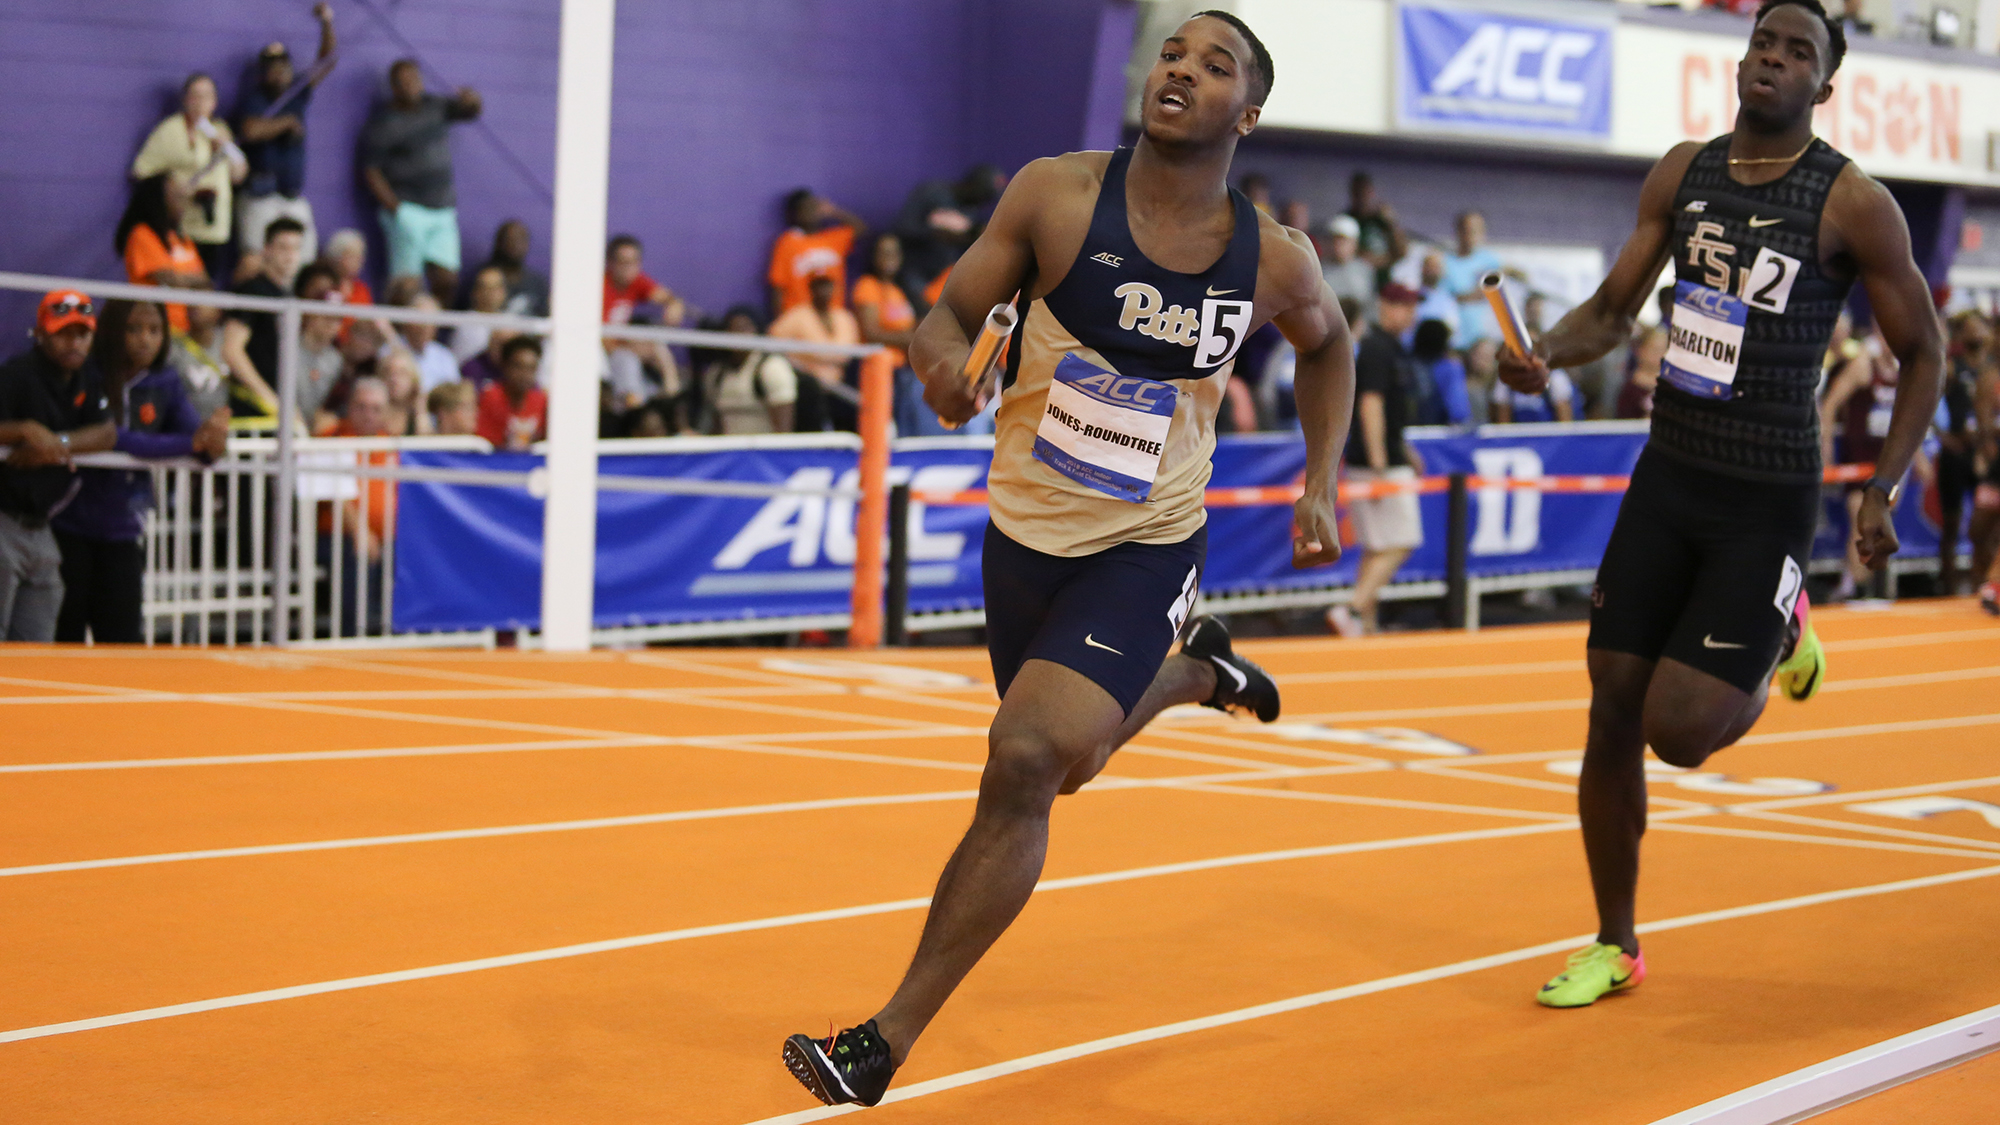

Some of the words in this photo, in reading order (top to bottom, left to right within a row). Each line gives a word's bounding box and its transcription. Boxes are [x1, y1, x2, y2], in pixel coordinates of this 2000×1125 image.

[1432, 22, 1595, 106] ACC
[1094, 251, 1124, 266] ACC
[1752, 256, 1788, 308] 2
[1114, 281, 1200, 347] Pitt
[1686, 288, 1736, 316] ACC
[1206, 304, 1241, 364] 5
[1075, 372, 1166, 404] ACC
[1046, 402, 1163, 457] JONES-ROUNDTREE
